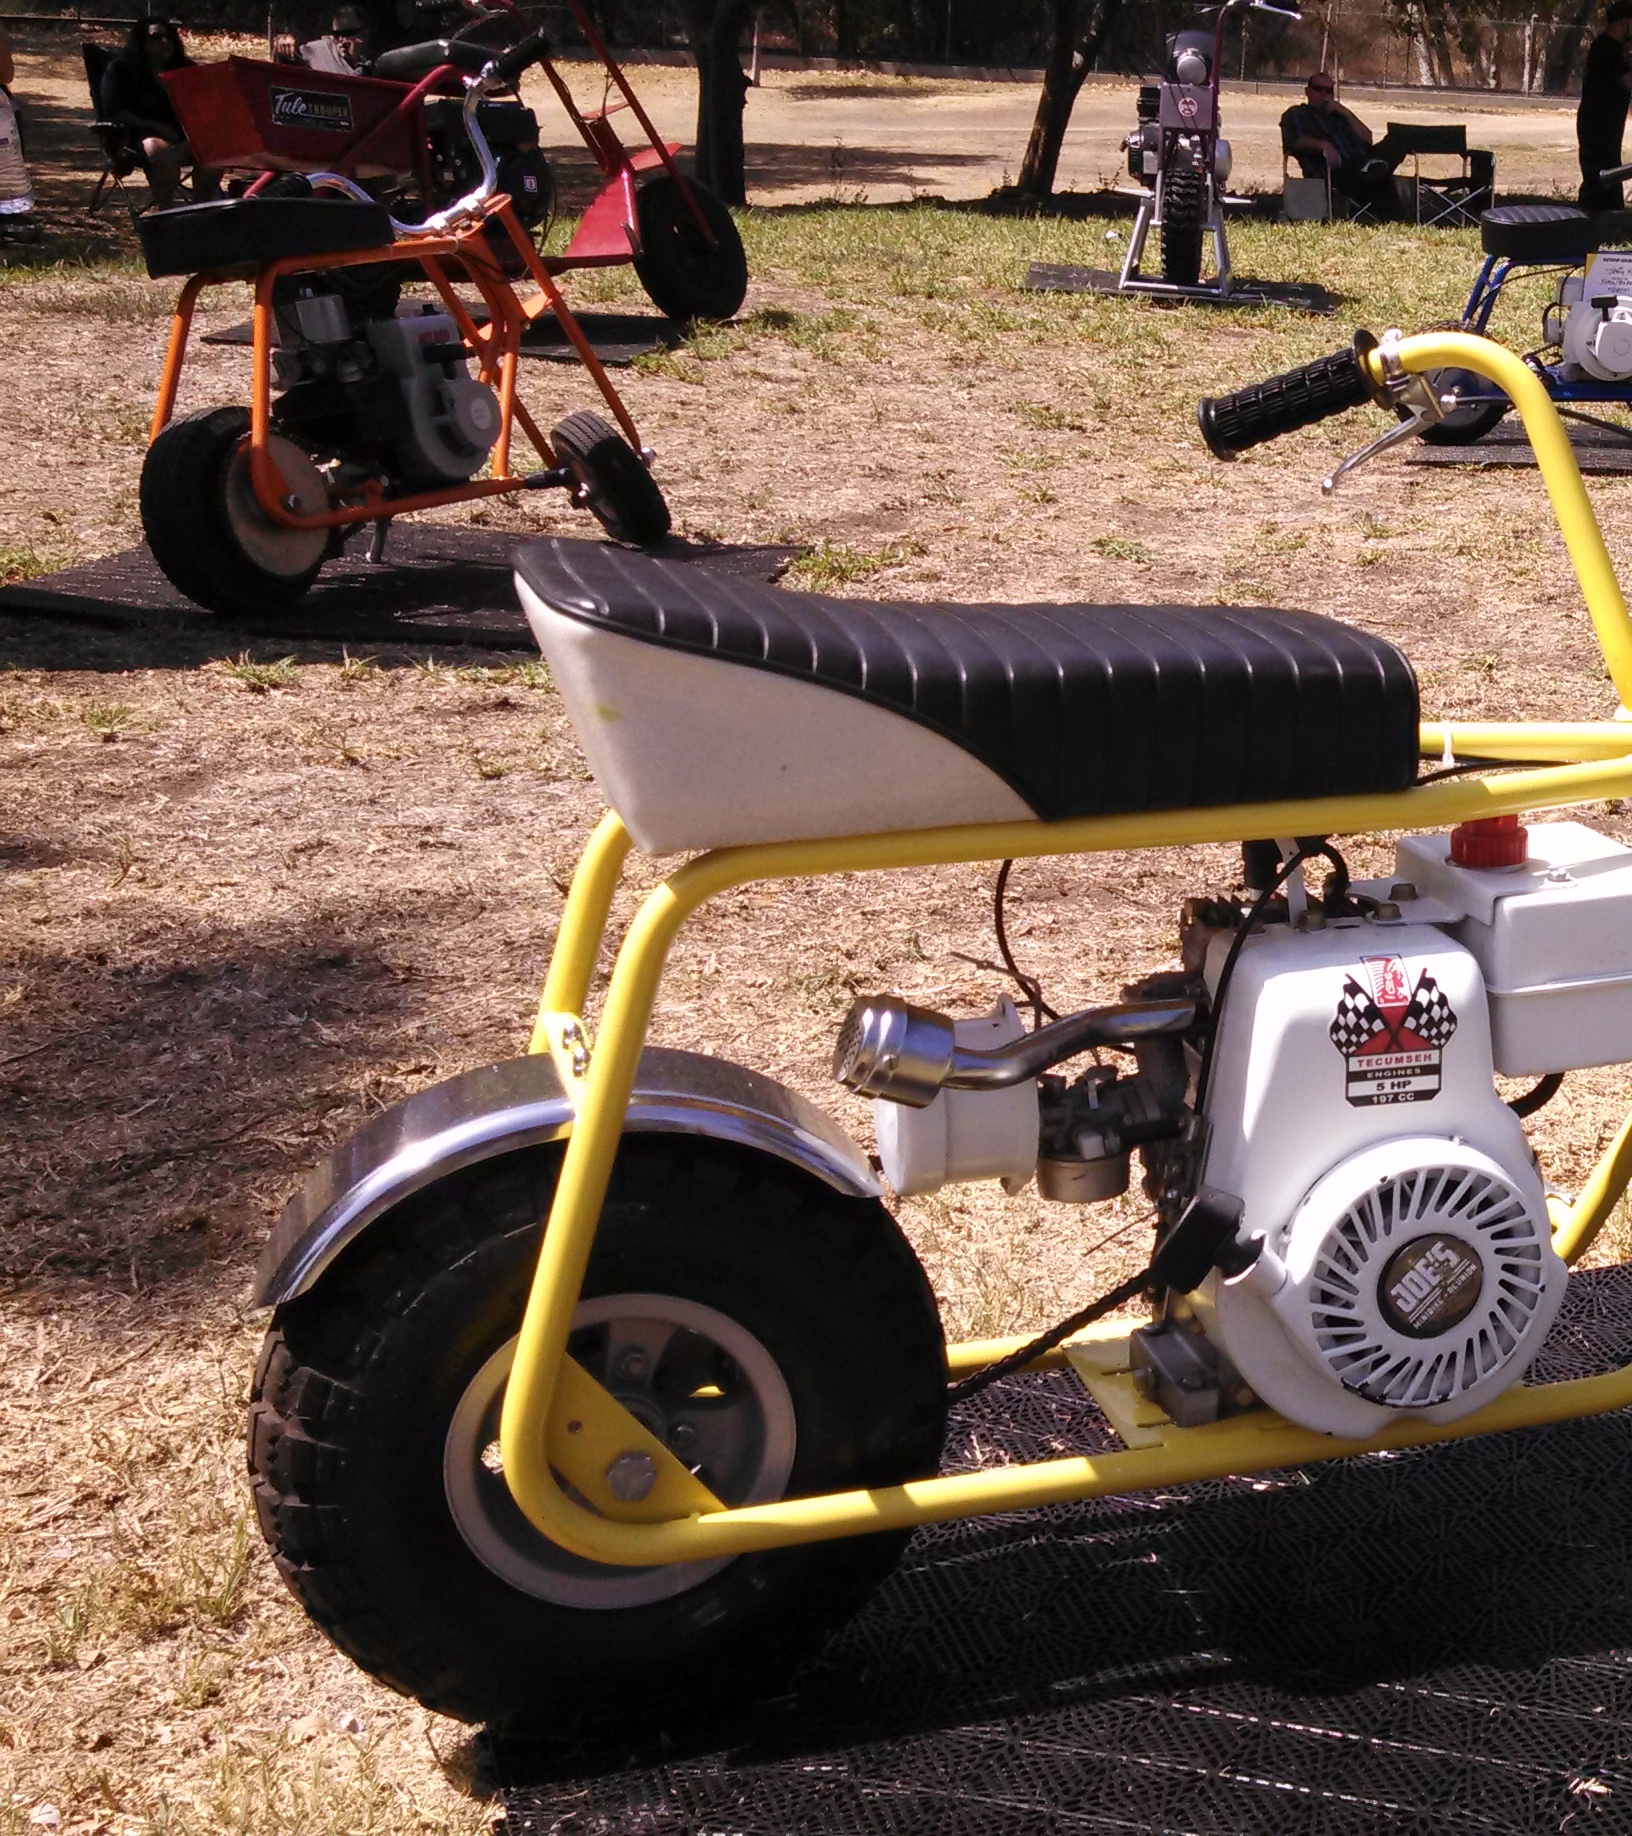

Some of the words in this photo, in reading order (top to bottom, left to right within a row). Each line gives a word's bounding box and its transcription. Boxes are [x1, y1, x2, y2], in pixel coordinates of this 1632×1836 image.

[274, 92, 308, 115] Tule
[1358, 1053, 1432, 1068] TECUMSEH
[1367, 1068, 1421, 1078] ENGINES
[1376, 1082, 1385, 1092] 5
[1390, 1080, 1412, 1090] HP
[1371, 1094, 1394, 1104] 197
[1398, 1092, 1414, 1101] CC
[1390, 1240, 1460, 1312] JOE'S
